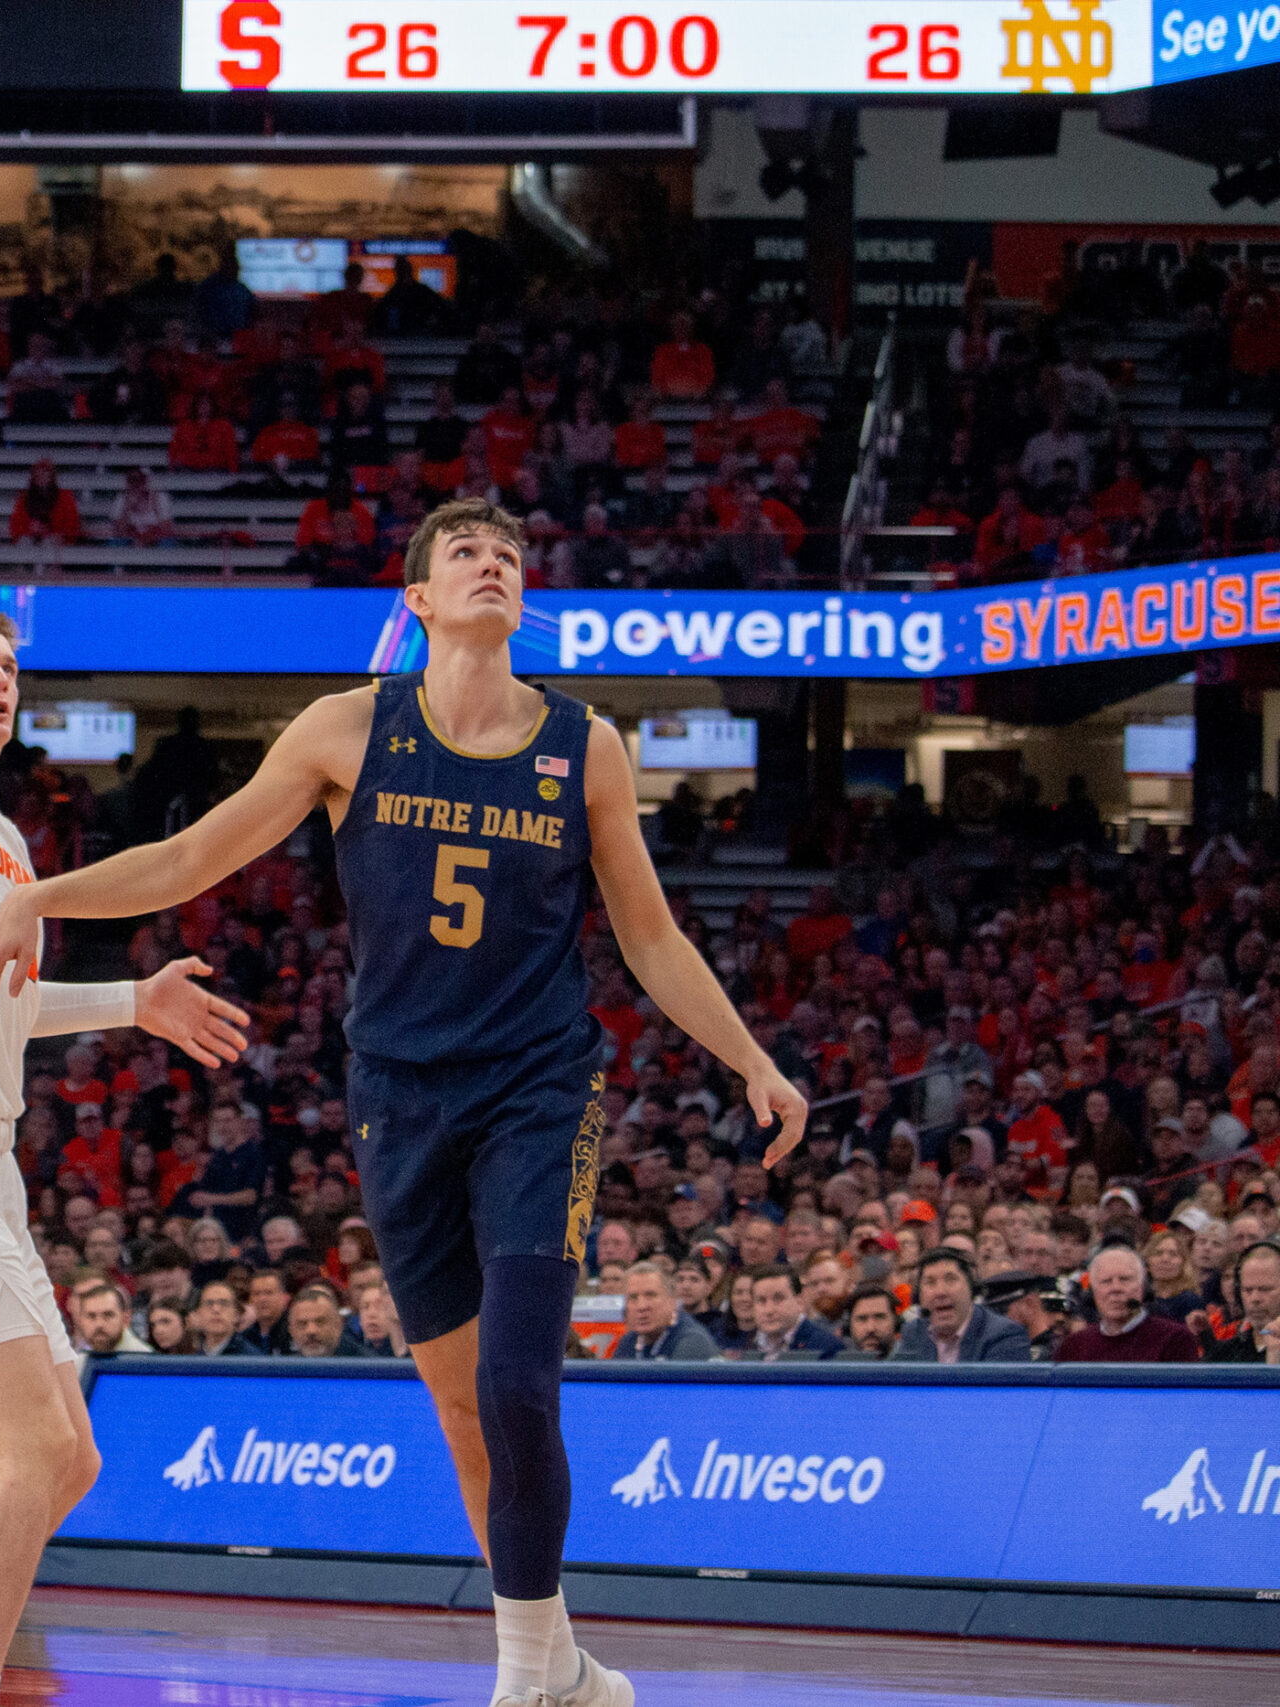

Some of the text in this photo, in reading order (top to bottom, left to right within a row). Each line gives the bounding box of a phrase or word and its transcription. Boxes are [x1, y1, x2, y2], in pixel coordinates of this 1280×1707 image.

[346, 23, 438, 79] 26
[517, 15, 720, 78] 7:00
[867, 24, 961, 80] 26
[1160, 3, 1280, 62] See yo
[558, 597, 943, 672] powering
[981, 568, 1280, 664] SYRACUSE
[375, 792, 565, 849] NOTRE DAME
[429, 844, 490, 949] 5
[230, 1427, 396, 1488] Invesco
[691, 1438, 885, 1504] Invesco
